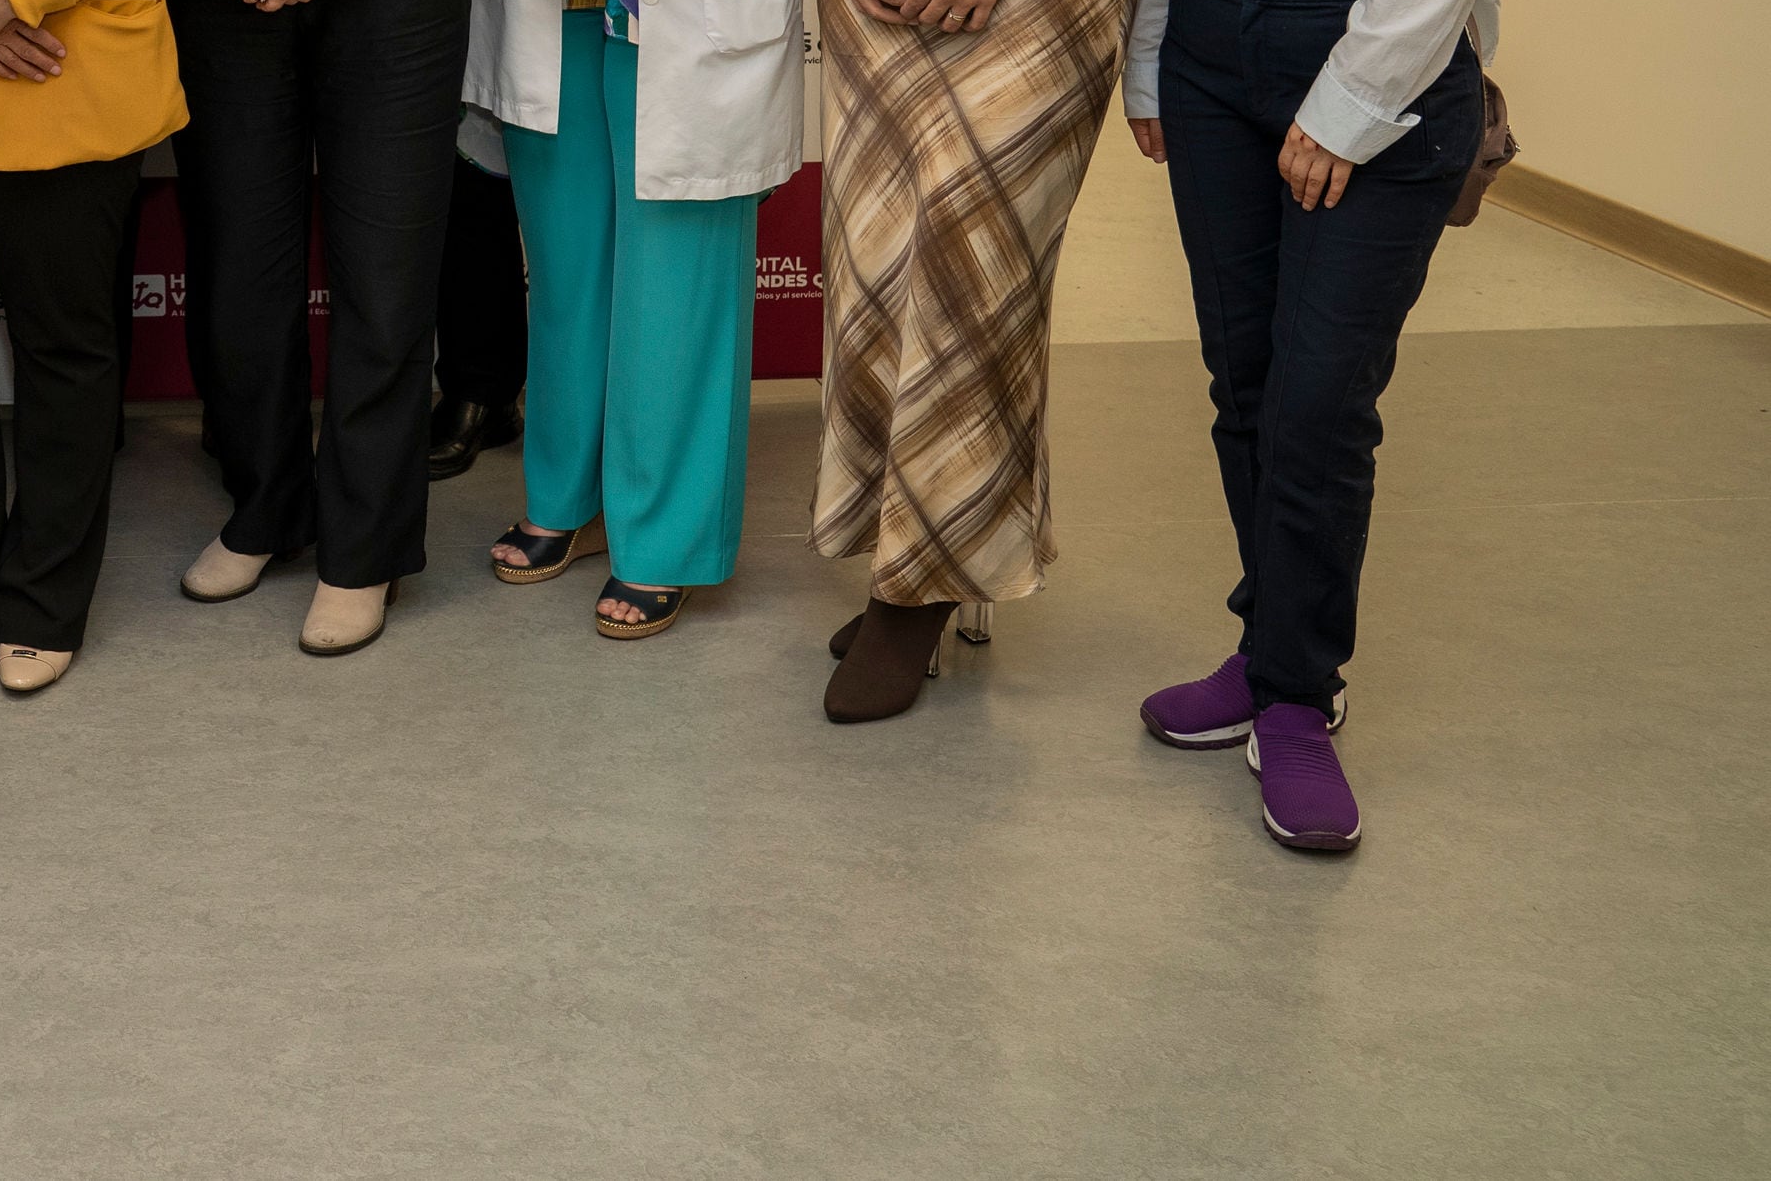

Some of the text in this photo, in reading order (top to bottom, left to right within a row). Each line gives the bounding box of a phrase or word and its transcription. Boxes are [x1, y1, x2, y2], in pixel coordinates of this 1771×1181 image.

[756, 274, 807, 288] NDES
[756, 291, 774, 300] Dios
[791, 291, 822, 299] servicio
